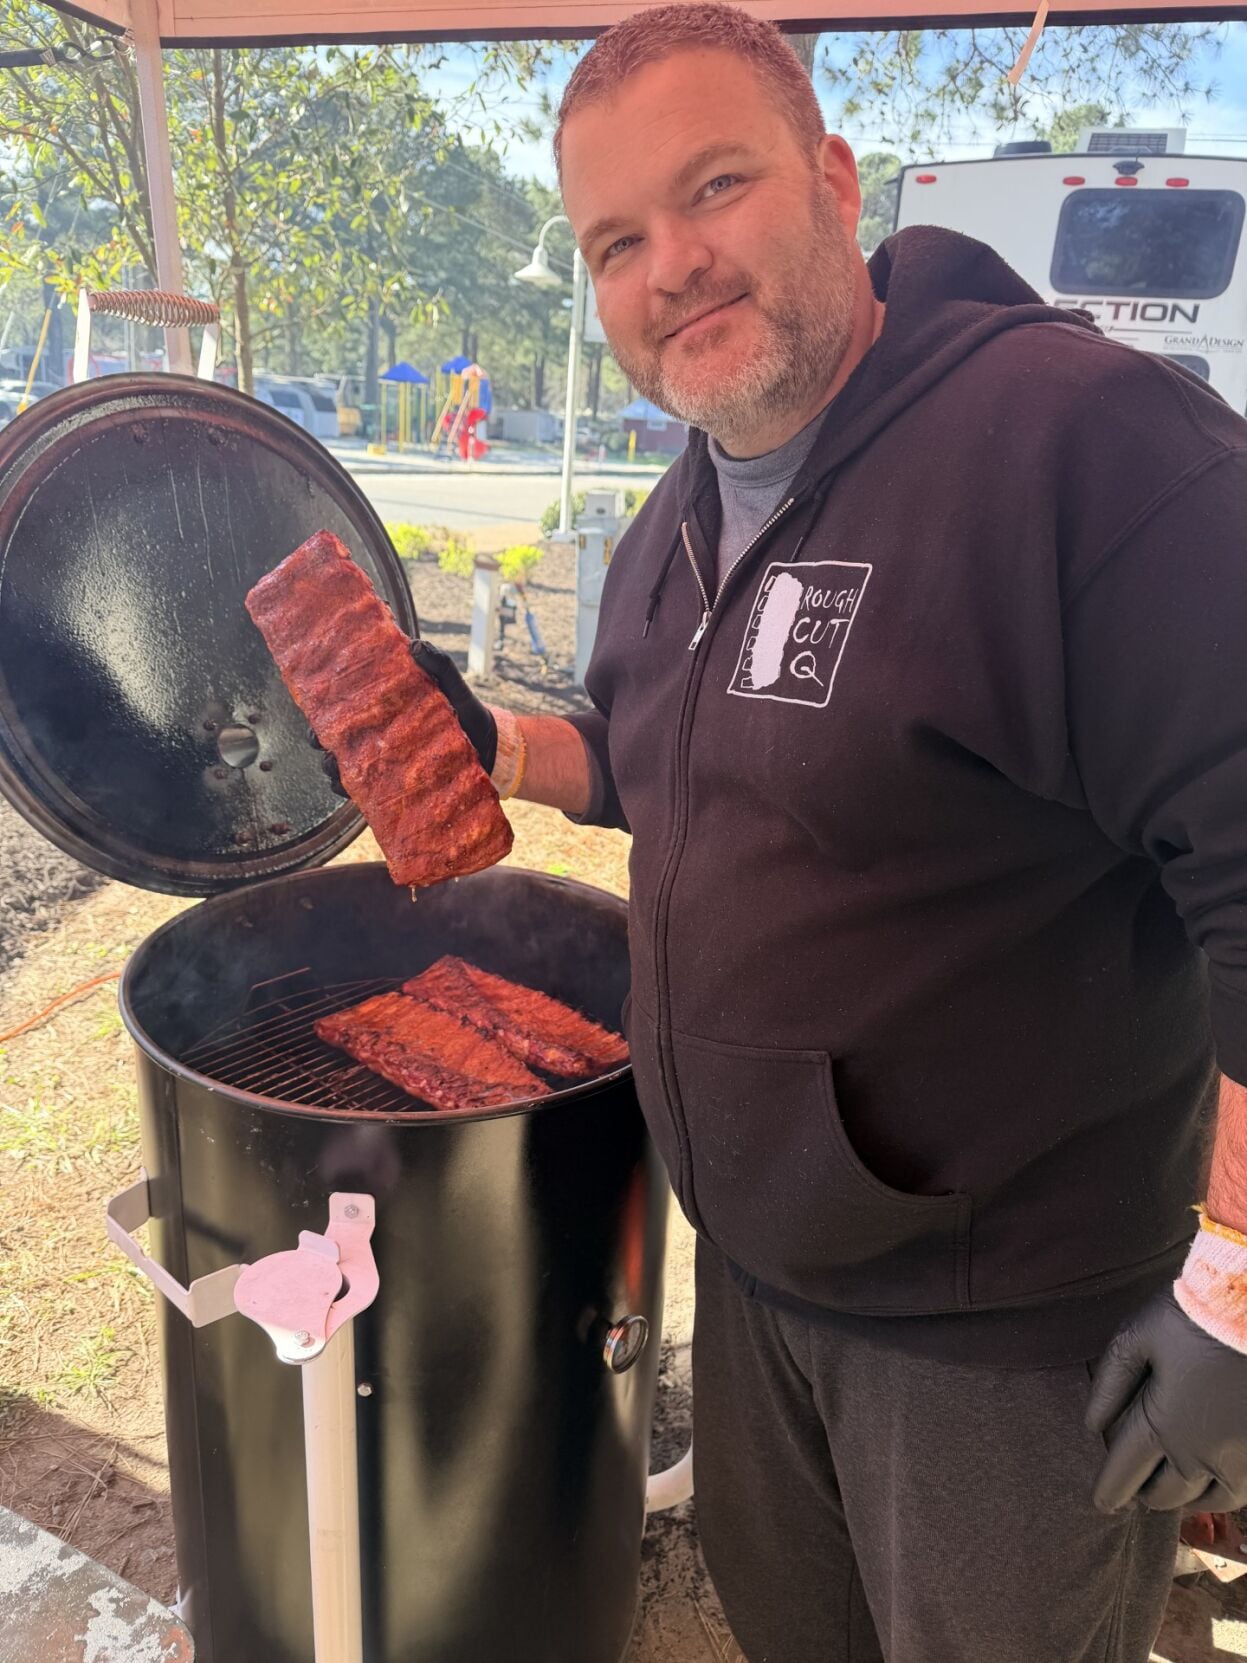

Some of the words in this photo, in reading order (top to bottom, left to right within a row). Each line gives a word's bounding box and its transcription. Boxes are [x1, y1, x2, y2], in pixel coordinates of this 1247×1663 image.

[801, 586, 859, 613] ROUGH
[793, 617, 850, 649] CUT
[789, 650, 825, 687] Q
